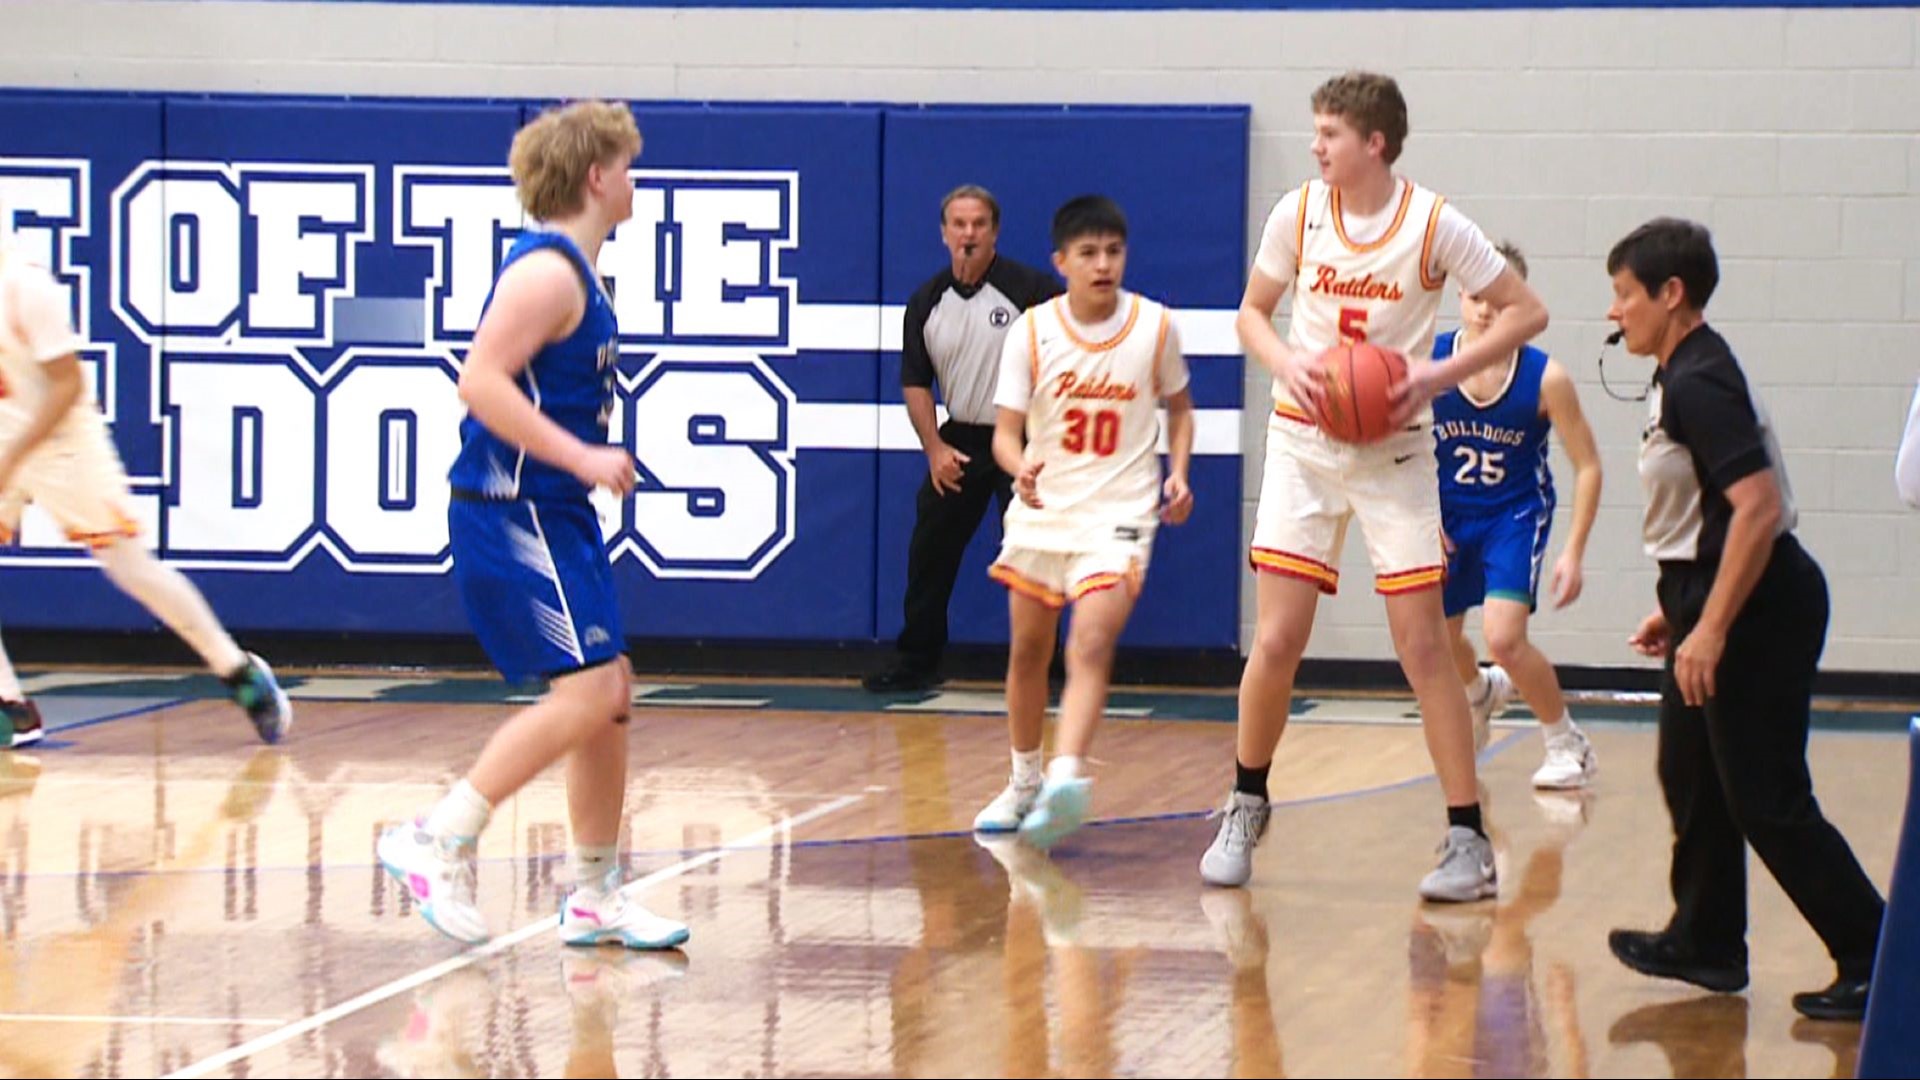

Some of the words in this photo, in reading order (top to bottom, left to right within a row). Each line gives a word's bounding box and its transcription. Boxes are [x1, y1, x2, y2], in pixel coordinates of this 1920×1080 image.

[111, 160, 375, 347] OF
[1310, 264, 1403, 301] Raiders
[1338, 306, 1369, 346] 5
[1054, 369, 1137, 401] Raiders
[1061, 408, 1121, 457] 30
[1433, 419, 1525, 446] BULLDOGS
[0, 343, 798, 580] DOS
[1453, 445, 1505, 486] 25
